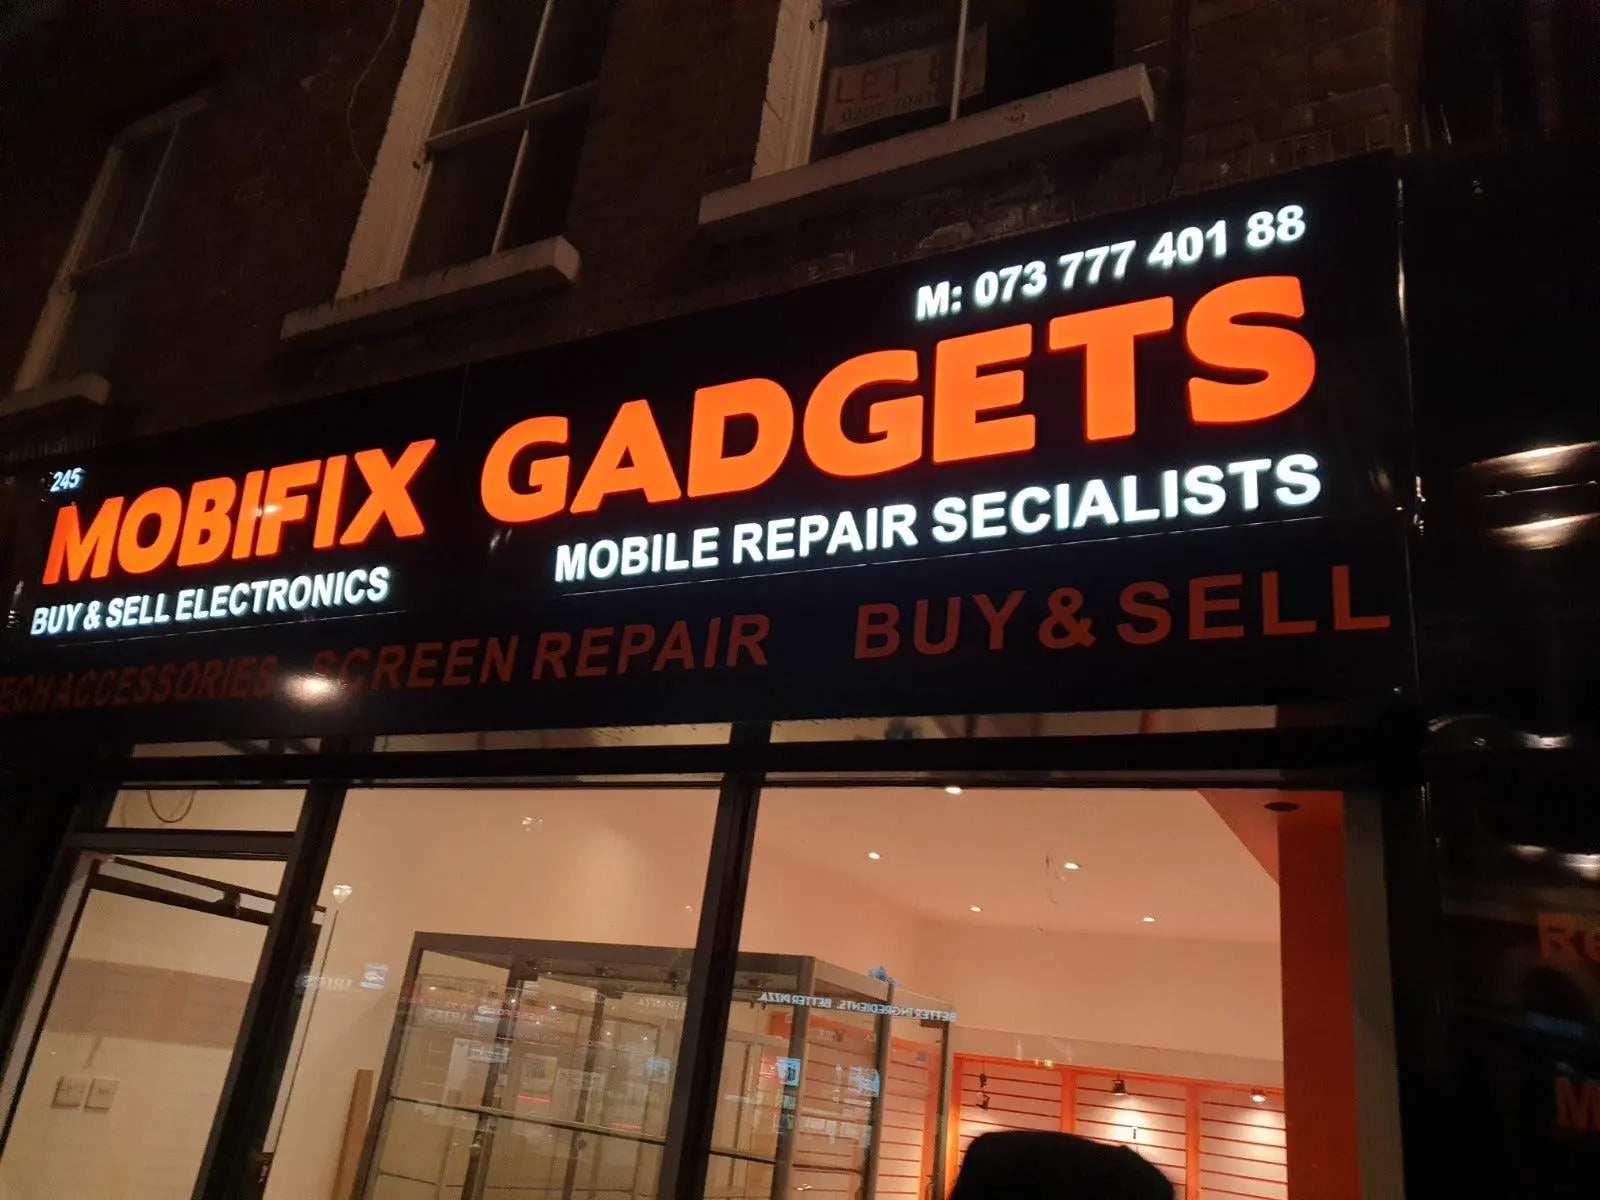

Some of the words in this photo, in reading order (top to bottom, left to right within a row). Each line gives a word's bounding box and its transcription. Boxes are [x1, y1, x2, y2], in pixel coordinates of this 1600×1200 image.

[835, 57, 914, 103] LET
[916, 281, 963, 321] M:
[974, 261, 1047, 307] 073
[1058, 240, 1137, 290] 777
[1147, 219, 1227, 268] 401
[1246, 204, 1306, 250] 88
[40, 438, 437, 586] MOBIFIX
[479, 274, 1317, 524] GADGETS
[50, 466, 84, 493] 245
[554, 525, 721, 583] MOBILE
[731, 503, 919, 564] REPAIR
[931, 453, 1322, 544] SECIALISTS
[29, 603, 85, 636] BUY
[82, 600, 102, 632] &
[105, 589, 171, 629] SELL
[174, 565, 392, 623] ELECTRONICS
[50, 654, 279, 711] ACCESSORIES
[311, 632, 519, 694] SCREEN
[531, 612, 771, 681] REPAIR
[853, 588, 1027, 661] BUY
[1037, 585, 1098, 652] &
[1116, 563, 1393, 648] SELL
